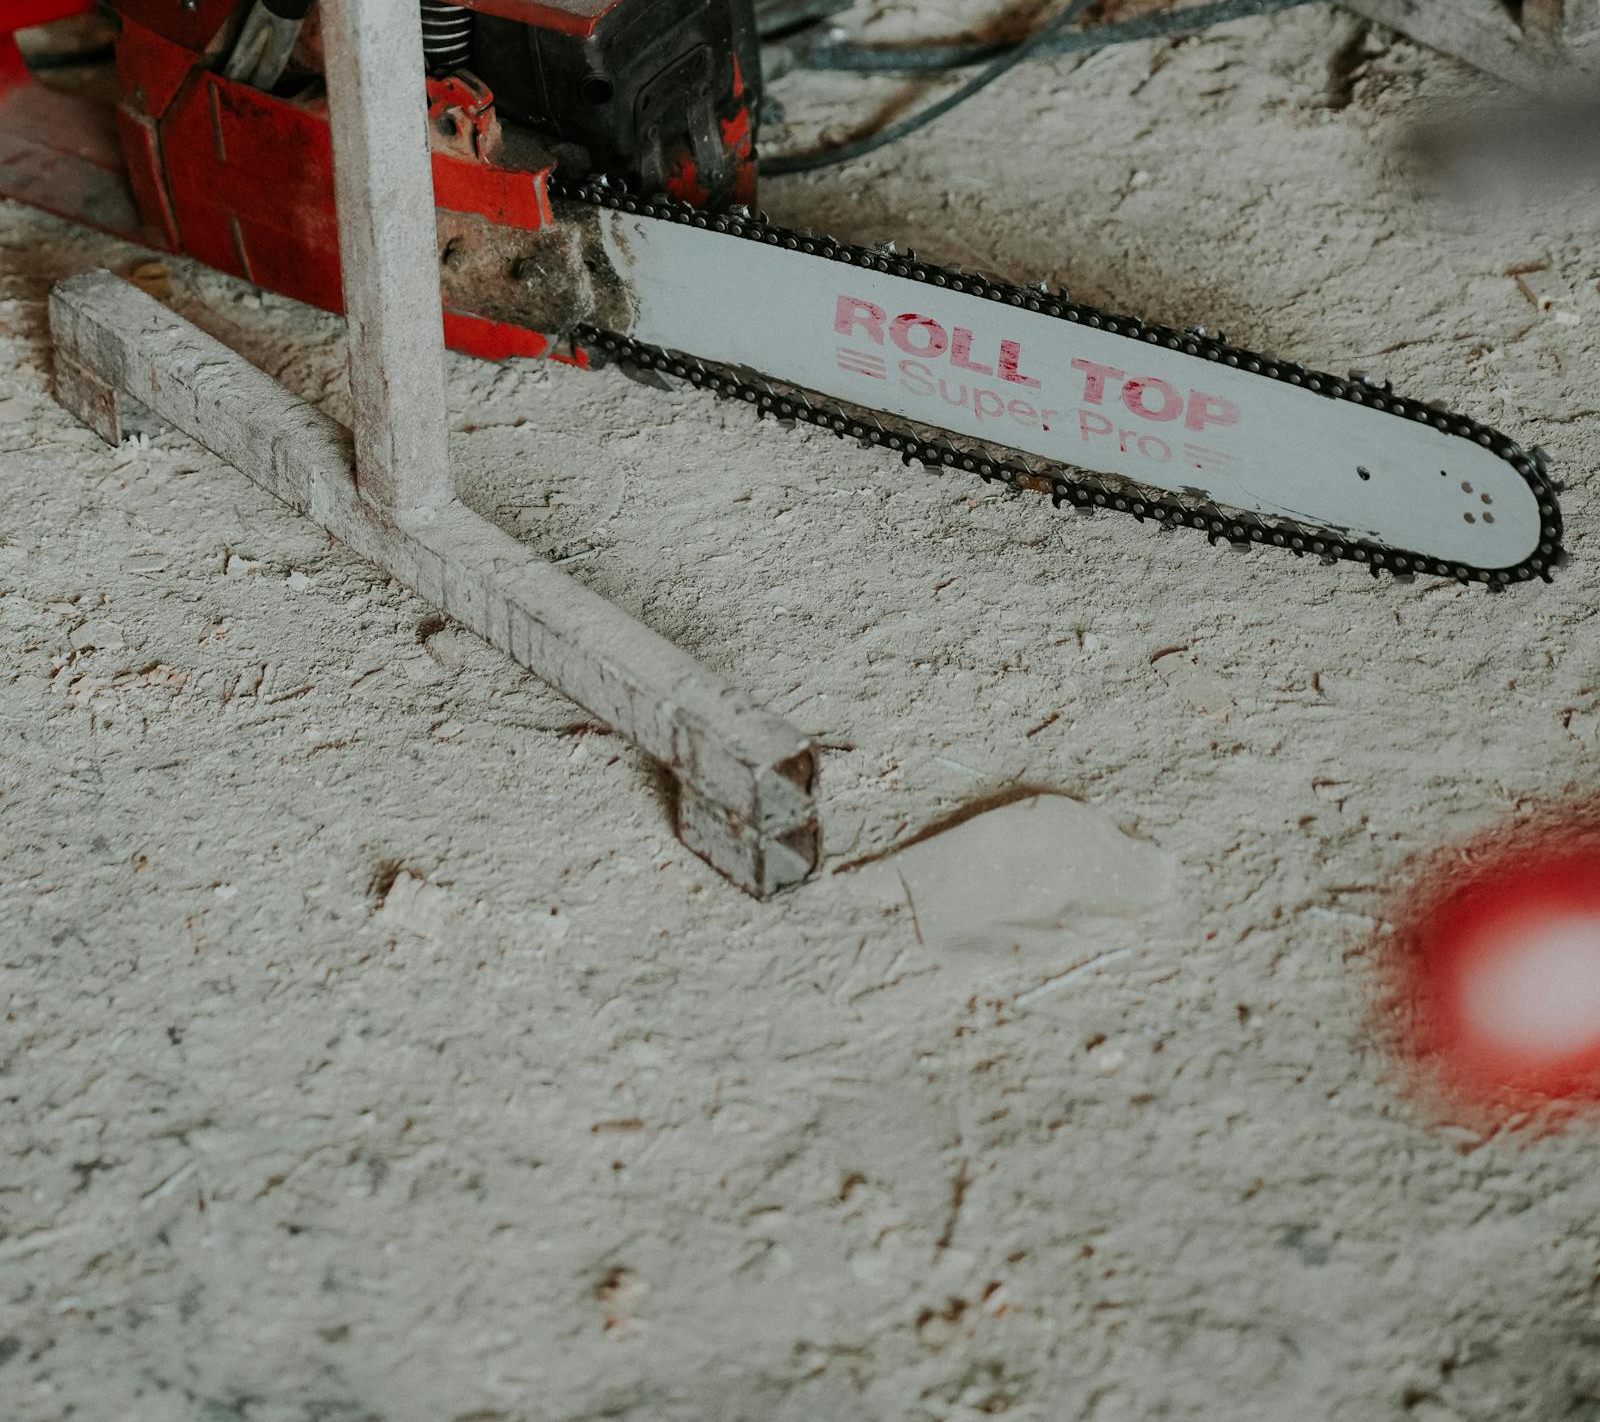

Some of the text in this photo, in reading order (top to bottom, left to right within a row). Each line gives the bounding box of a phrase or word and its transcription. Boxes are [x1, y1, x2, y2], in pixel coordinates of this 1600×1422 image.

[834, 295, 1241, 431] ROLL TOP
[898, 359, 1172, 459] Super Pro
